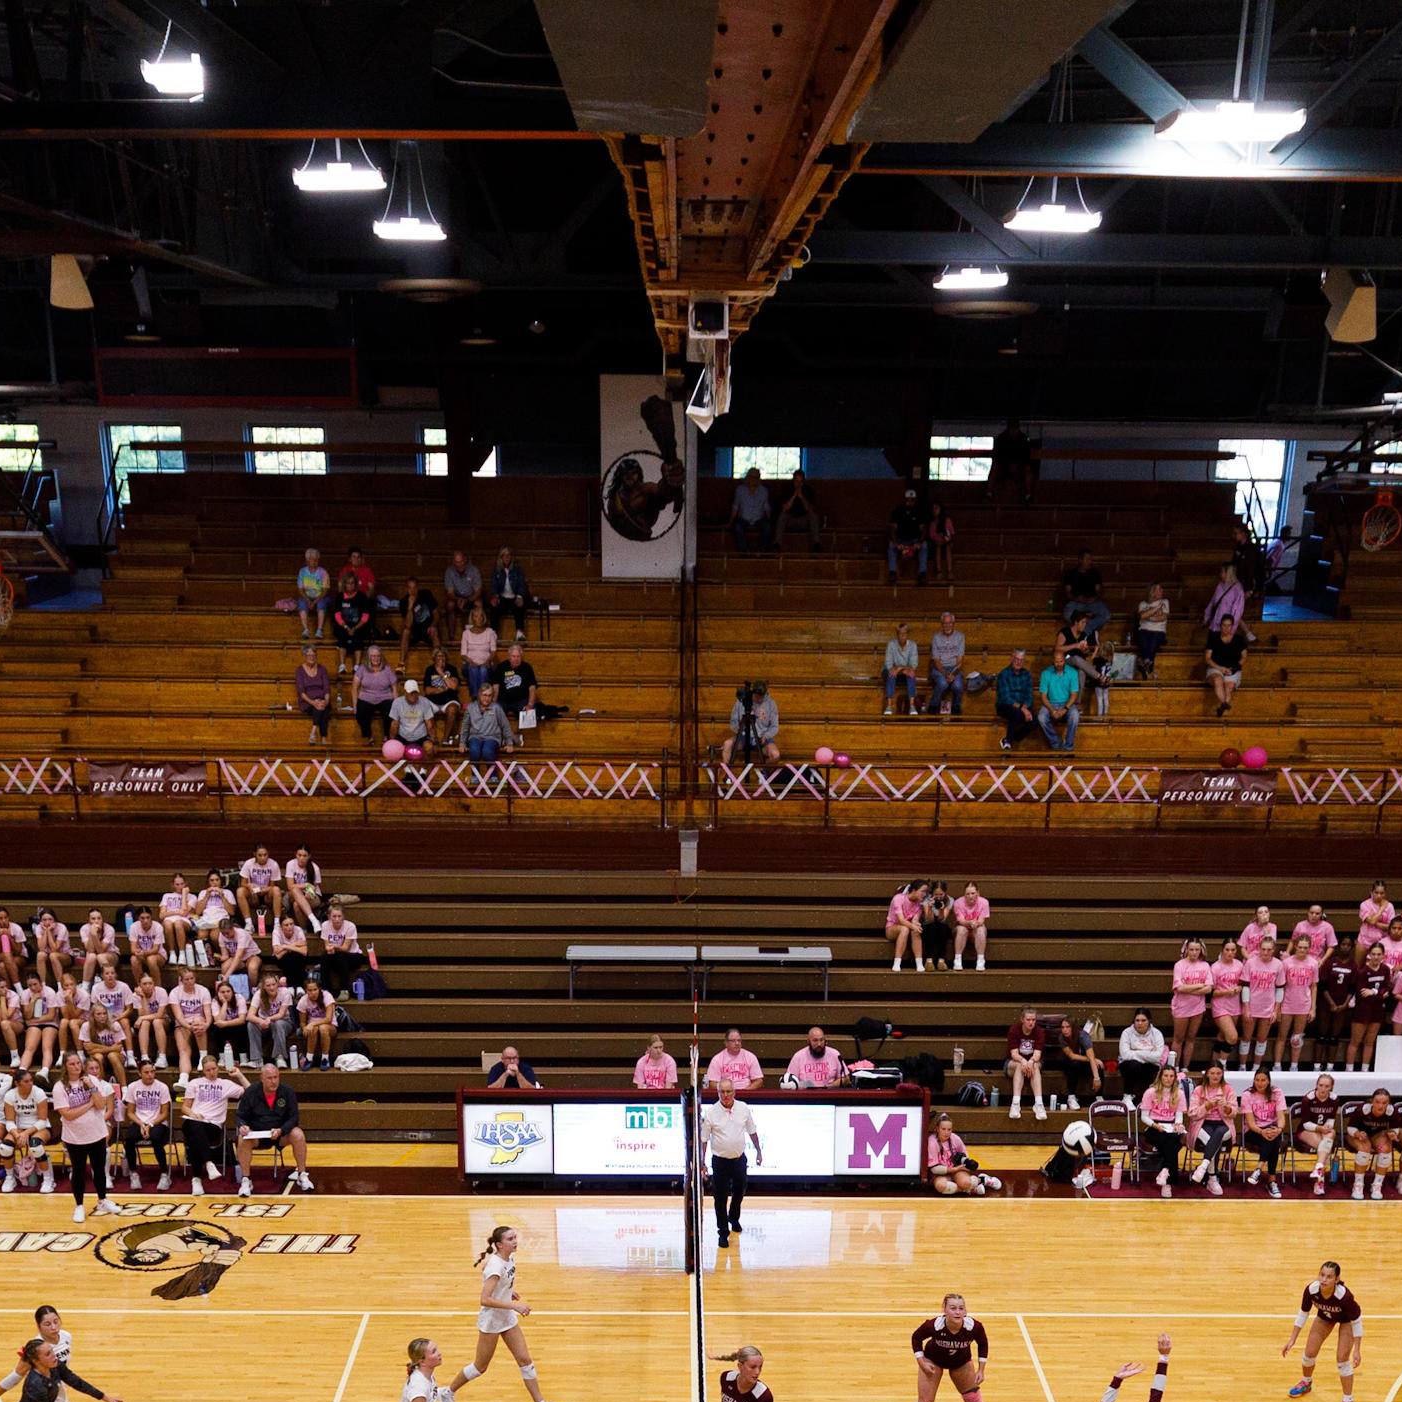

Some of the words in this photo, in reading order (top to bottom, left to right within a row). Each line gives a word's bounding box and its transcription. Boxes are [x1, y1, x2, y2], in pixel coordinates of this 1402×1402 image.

[131, 767, 165, 777] TEAM
[93, 781, 165, 792] PERSONNEL
[171, 782, 205, 792] ONLY
[1202, 776, 1236, 787] TEAM
[1162, 790, 1234, 801] PERSONNEL
[1240, 791, 1274, 801] ONLY
[252, 868, 273, 876] PENN
[1337, 973, 1344, 984] 3
[135, 1089, 162, 1098] PENN
[1317, 1114, 1324, 1124] 2
[474, 1121, 544, 1150] IHSAA
[848, 1113, 907, 1169] M
[614, 1137, 656, 1151] inspire
[209, 1203, 296, 1218] EST.
[249, 1233, 361, 1255] THE
